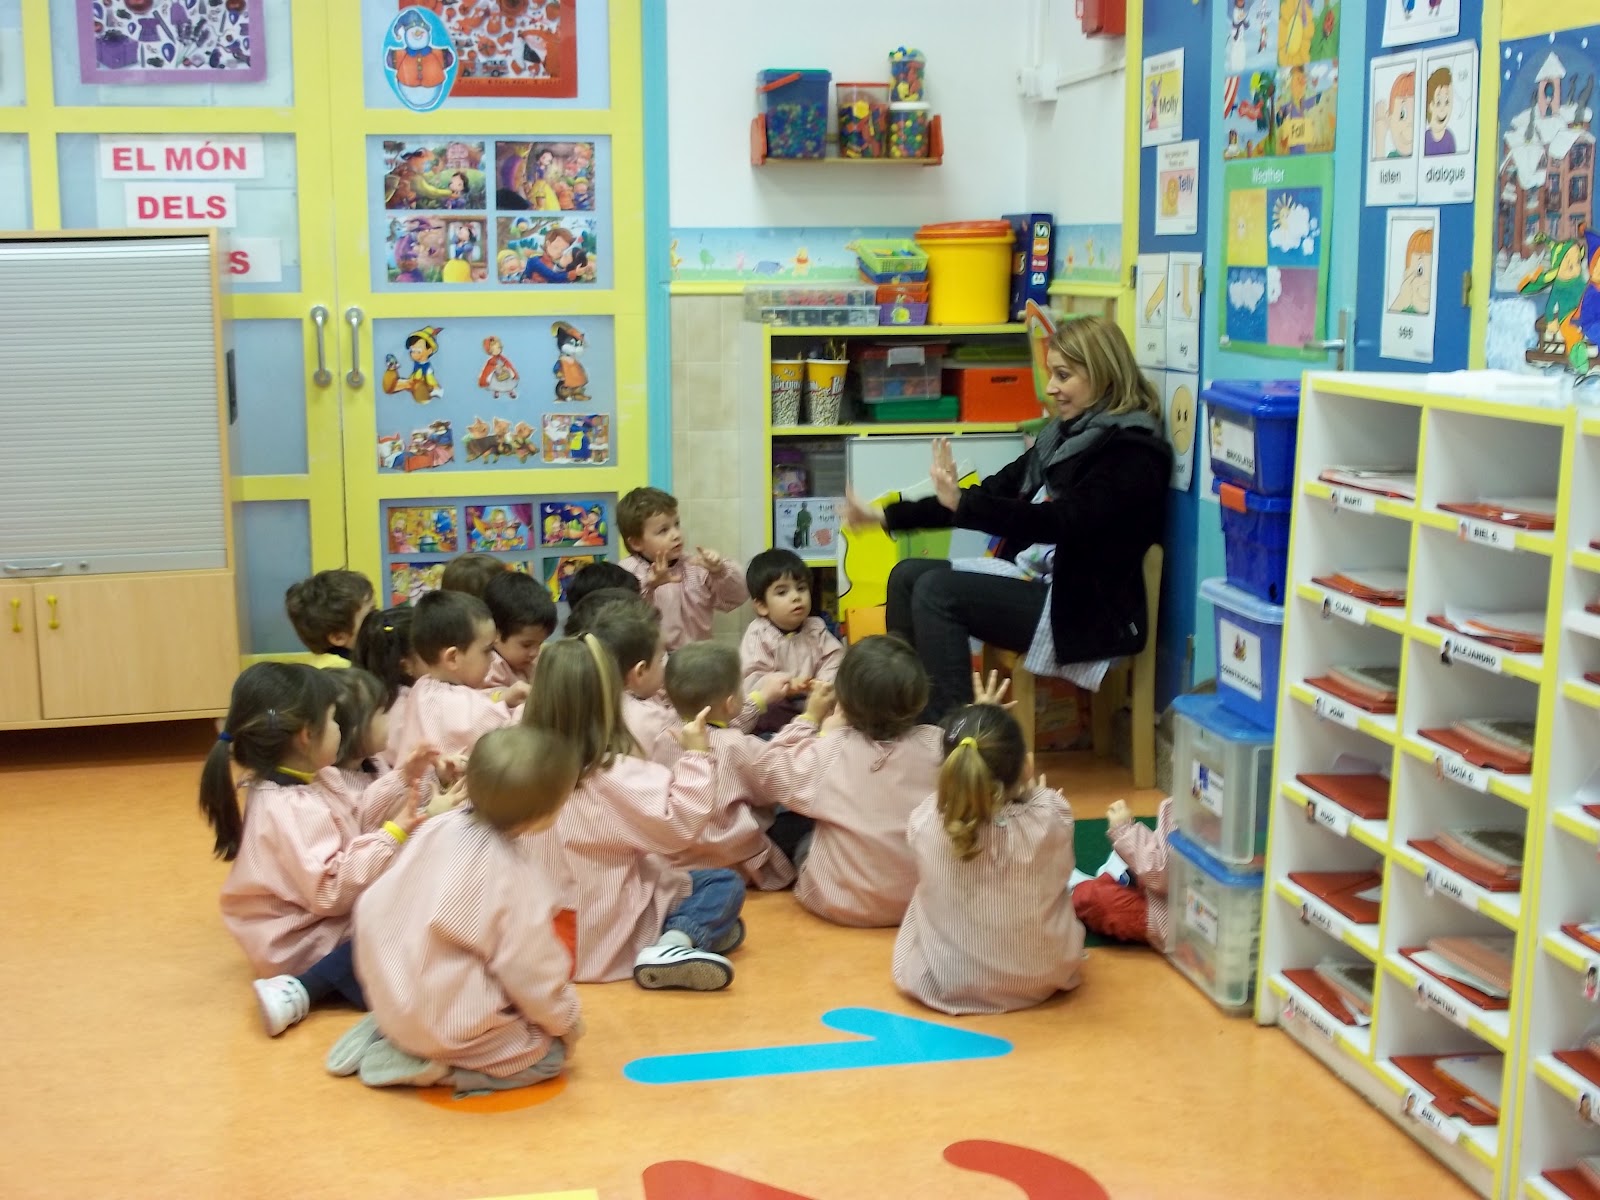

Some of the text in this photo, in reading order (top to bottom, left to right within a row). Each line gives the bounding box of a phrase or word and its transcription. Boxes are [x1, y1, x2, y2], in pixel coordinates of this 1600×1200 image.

[1159, 96, 1179, 115] Molly
[1291, 123, 1305, 138] Fall
[112, 141, 247, 171] EL MÓN
[1178, 174, 1194, 194] Telly
[1251, 167, 1286, 184] Weather
[1379, 170, 1401, 184] listen
[1425, 166, 1466, 185] dialogue
[137, 195, 227, 220] DELS
[1454, 644, 1496, 666] ALEJANDRO
[1441, 878, 1463, 898] LAURA
